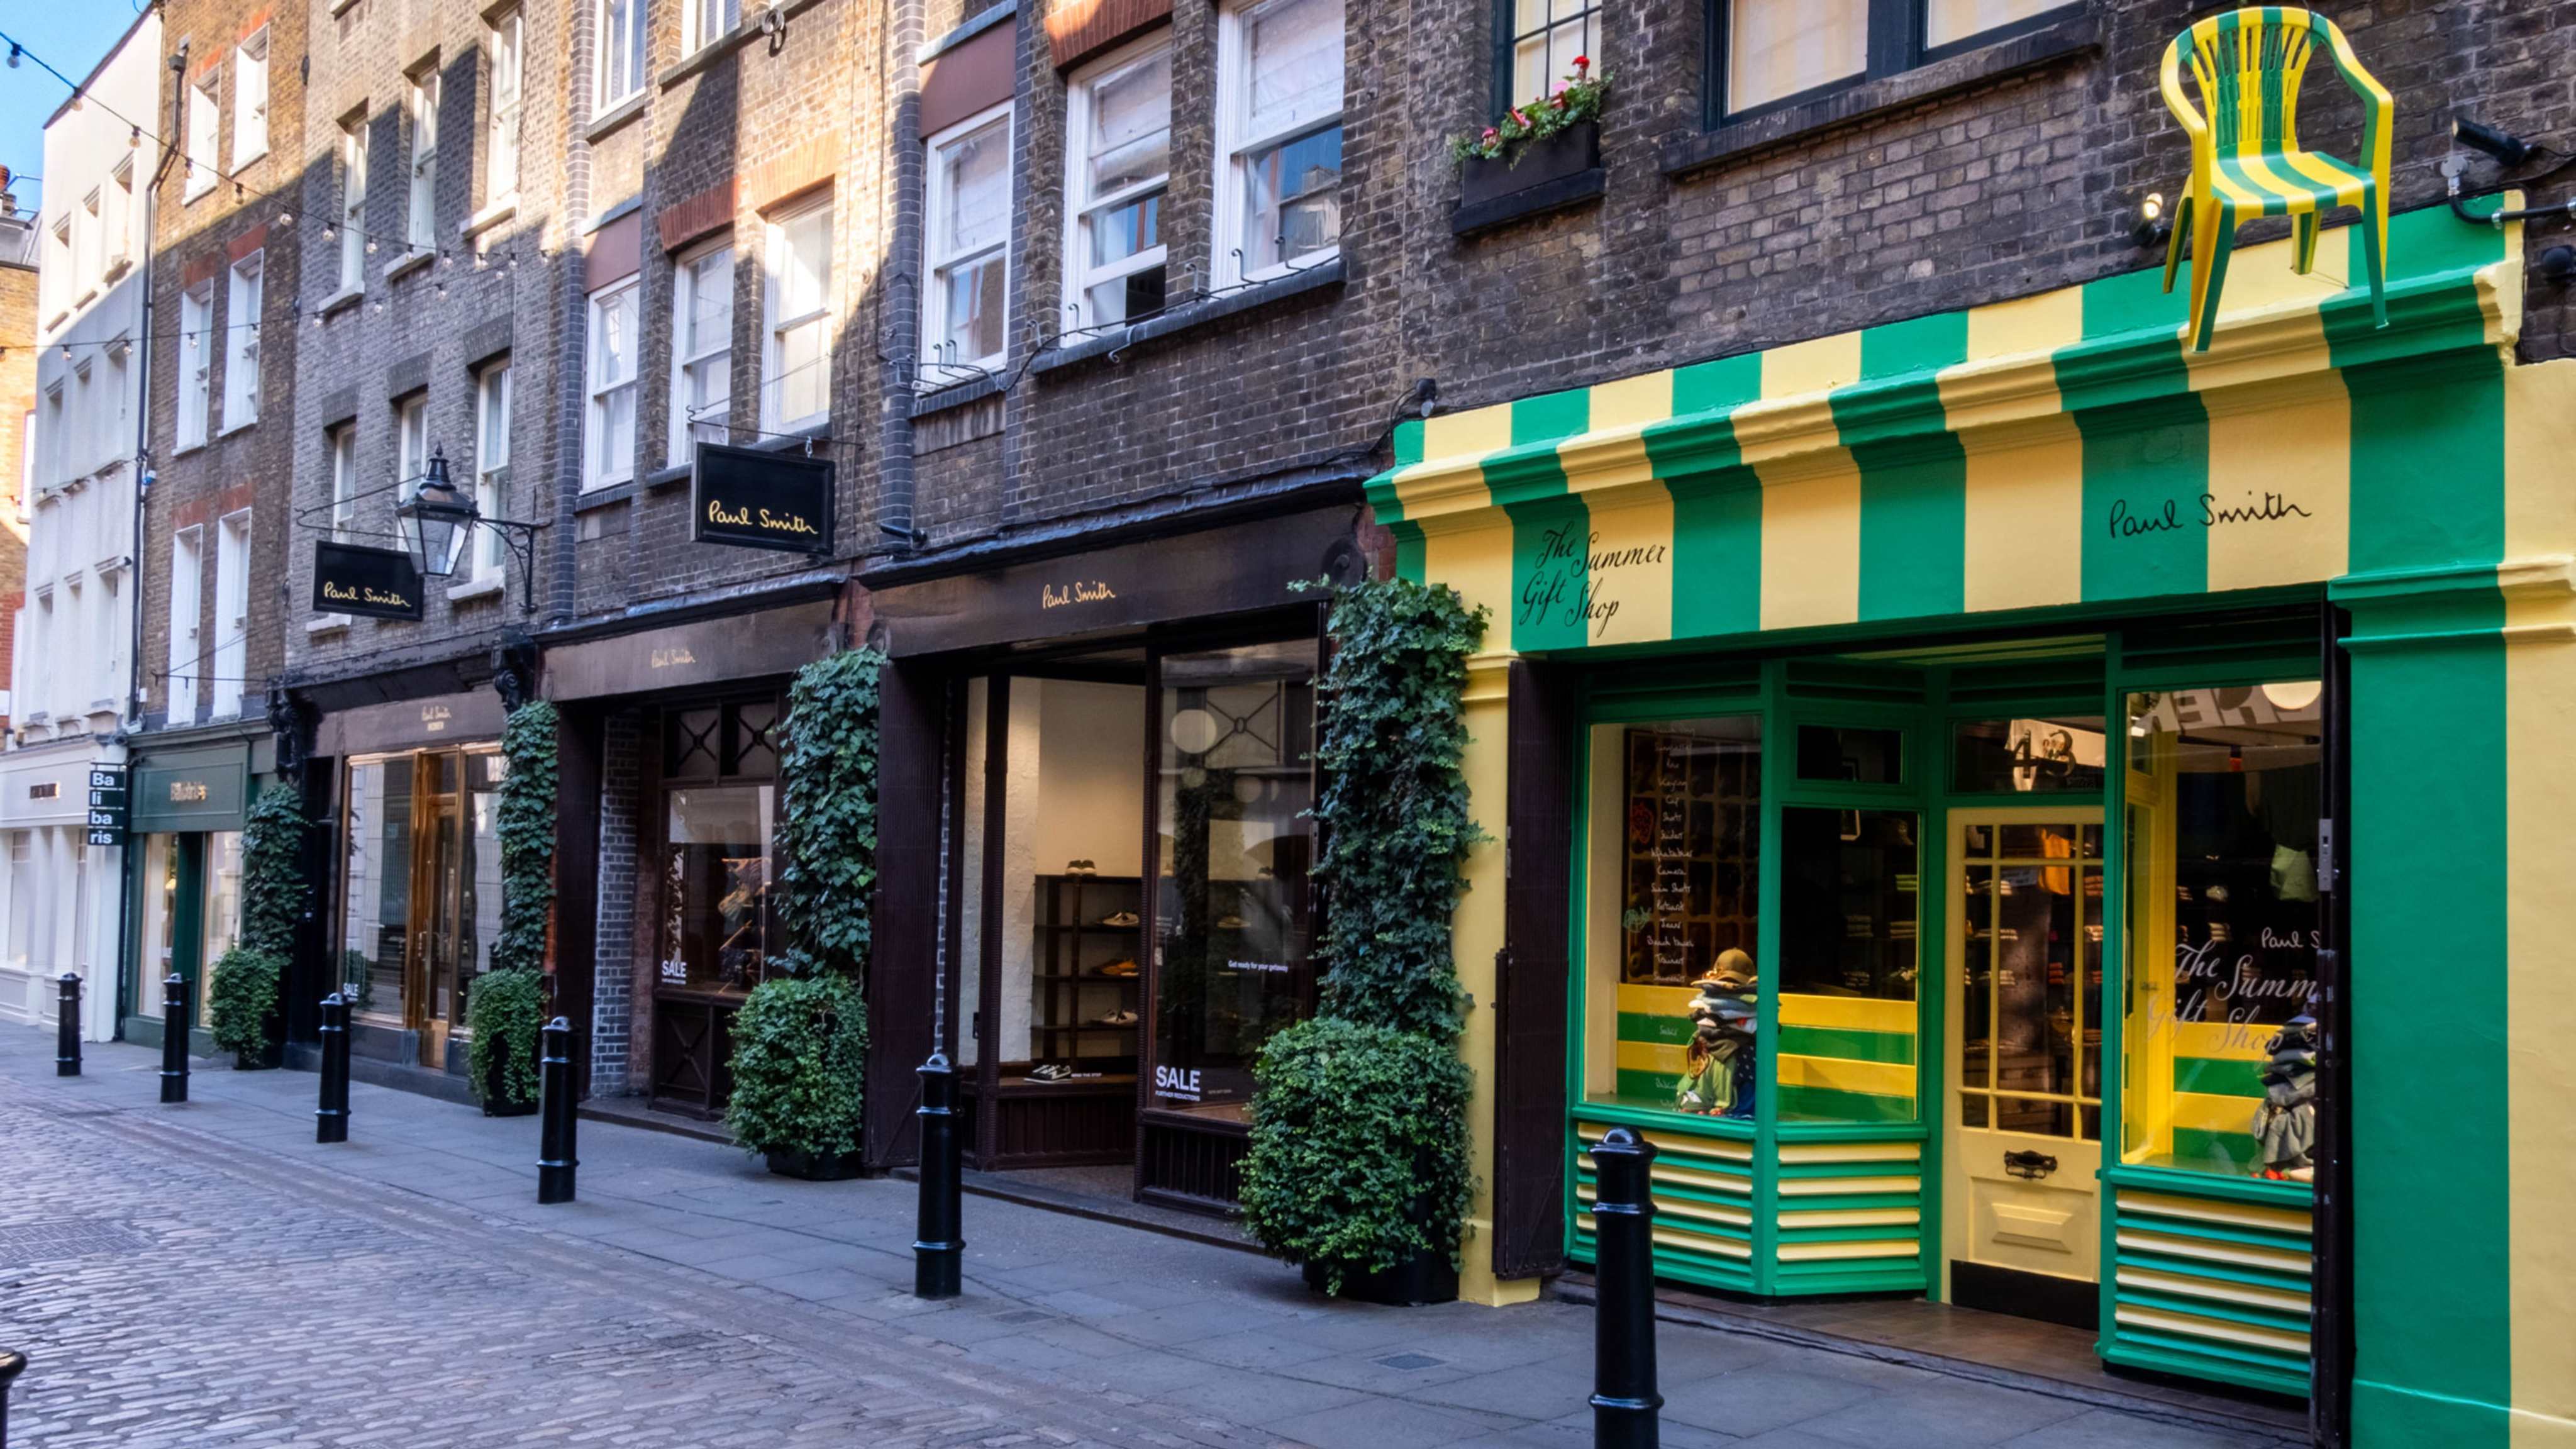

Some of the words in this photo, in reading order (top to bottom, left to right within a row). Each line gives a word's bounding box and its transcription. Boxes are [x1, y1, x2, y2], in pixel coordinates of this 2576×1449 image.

[709, 500, 753, 525] Paul
[759, 508, 818, 535] Smith
[2110, 499, 2184, 538] Paul
[2199, 491, 2312, 526] Smith
[1535, 521, 1576, 570] The
[1570, 531, 1666, 578] Summer
[324, 581, 359, 600] Paul
[364, 587, 411, 607] Smith
[1043, 584, 1070, 609] Paul
[1075, 580, 1116, 602] Smith
[1519, 569, 1567, 626] Gift
[1565, 577, 1620, 638] Shop
[652, 649, 669, 669] Paul
[670, 648, 696, 664] Smith
[2010, 728, 2076, 778] 43
[92, 772, 114, 786] Ba
[92, 791, 101, 805] li
[91, 811, 113, 825] ba
[90, 830, 113, 844] ris
[2261, 926, 2304, 948] Paul
[662, 960, 687, 977] SALE
[2172, 938, 2221, 982] The
[2213, 953, 2318, 1001] Summ
[343, 982, 359, 997] SALE
[2204, 1004, 2284, 1070] Shop
[1156, 1065, 1201, 1092] SALE
